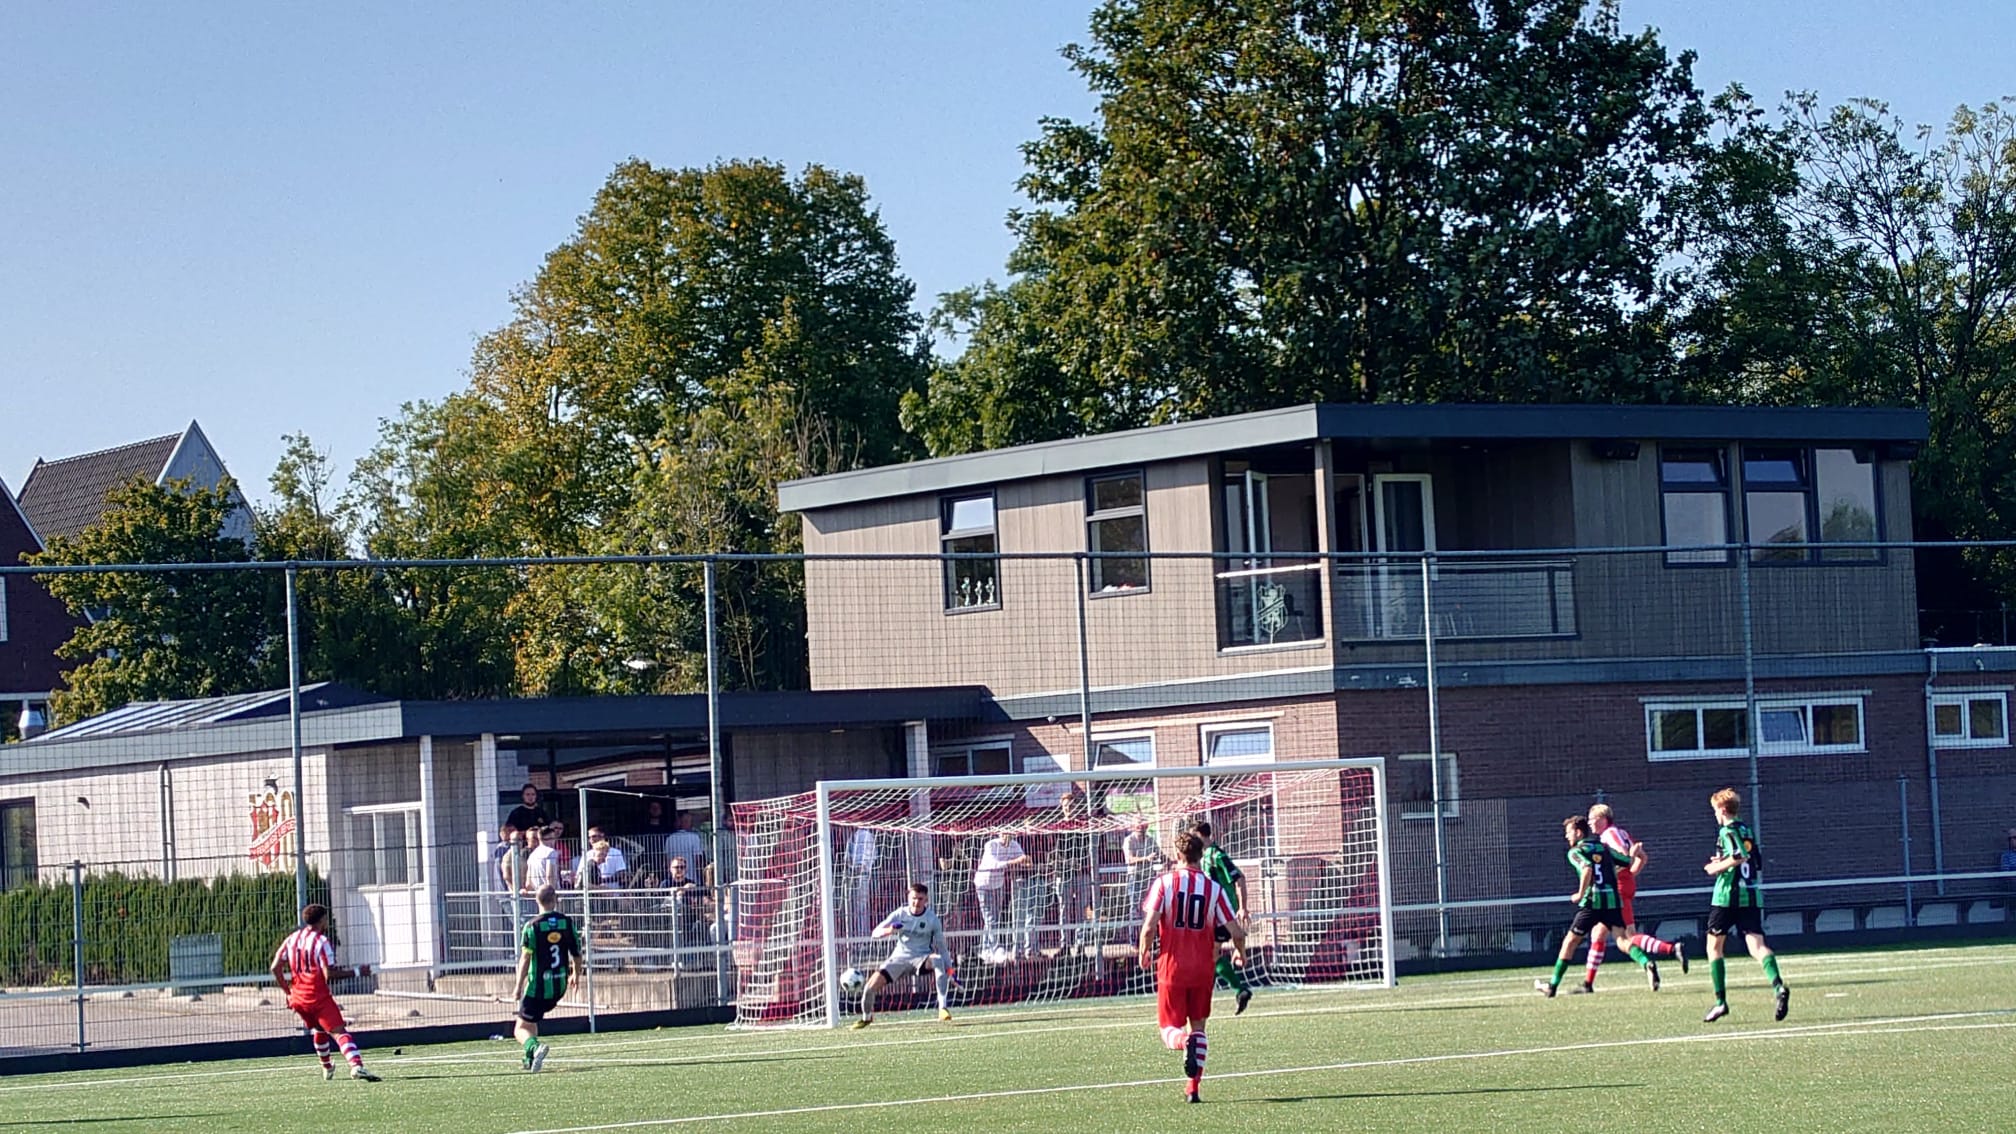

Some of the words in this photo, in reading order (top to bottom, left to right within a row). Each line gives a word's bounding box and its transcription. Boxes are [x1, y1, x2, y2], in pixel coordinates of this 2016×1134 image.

[1594, 863, 1604, 885] 5
[1174, 891, 1206, 930] 10
[296, 948, 312, 974] 11
[549, 943, 561, 969] 3
